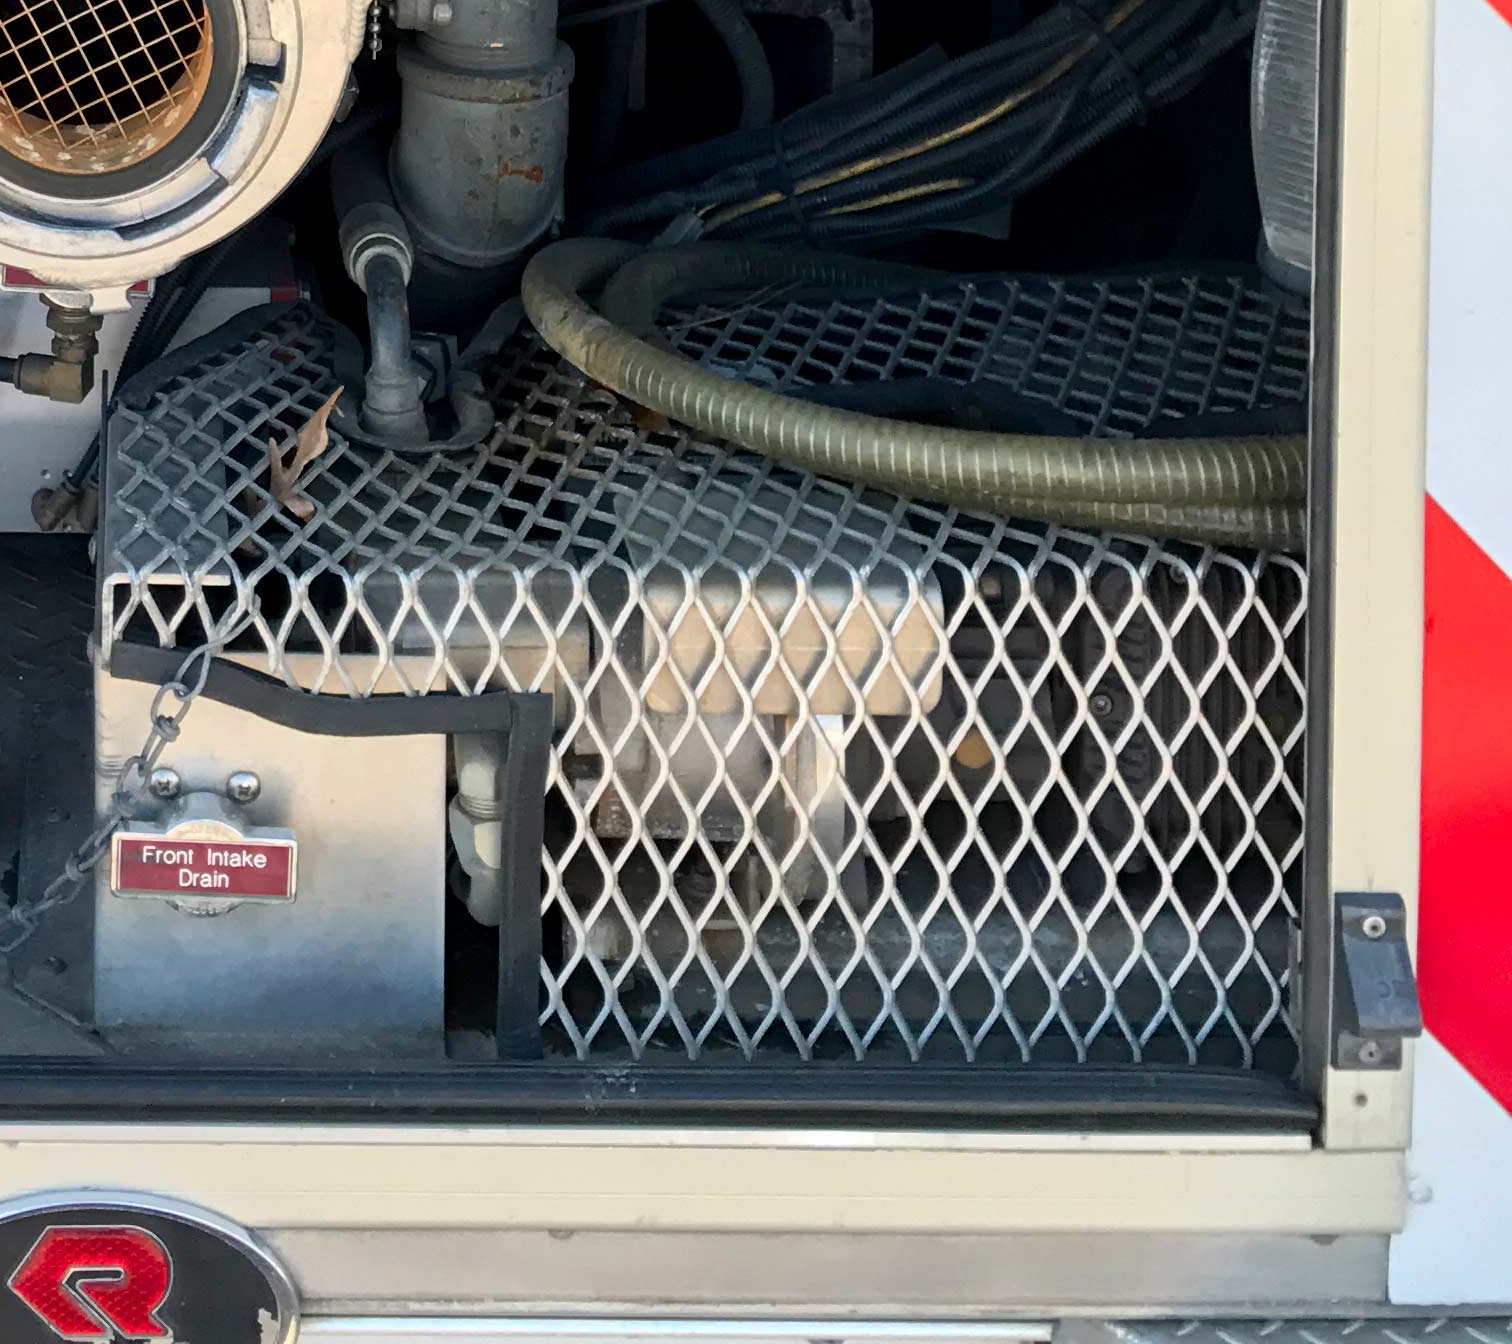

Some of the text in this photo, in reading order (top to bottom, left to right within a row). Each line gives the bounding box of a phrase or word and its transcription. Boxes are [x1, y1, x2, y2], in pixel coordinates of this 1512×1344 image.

[142, 844, 267, 869] Front Intake
[178, 868, 230, 888] Drain
